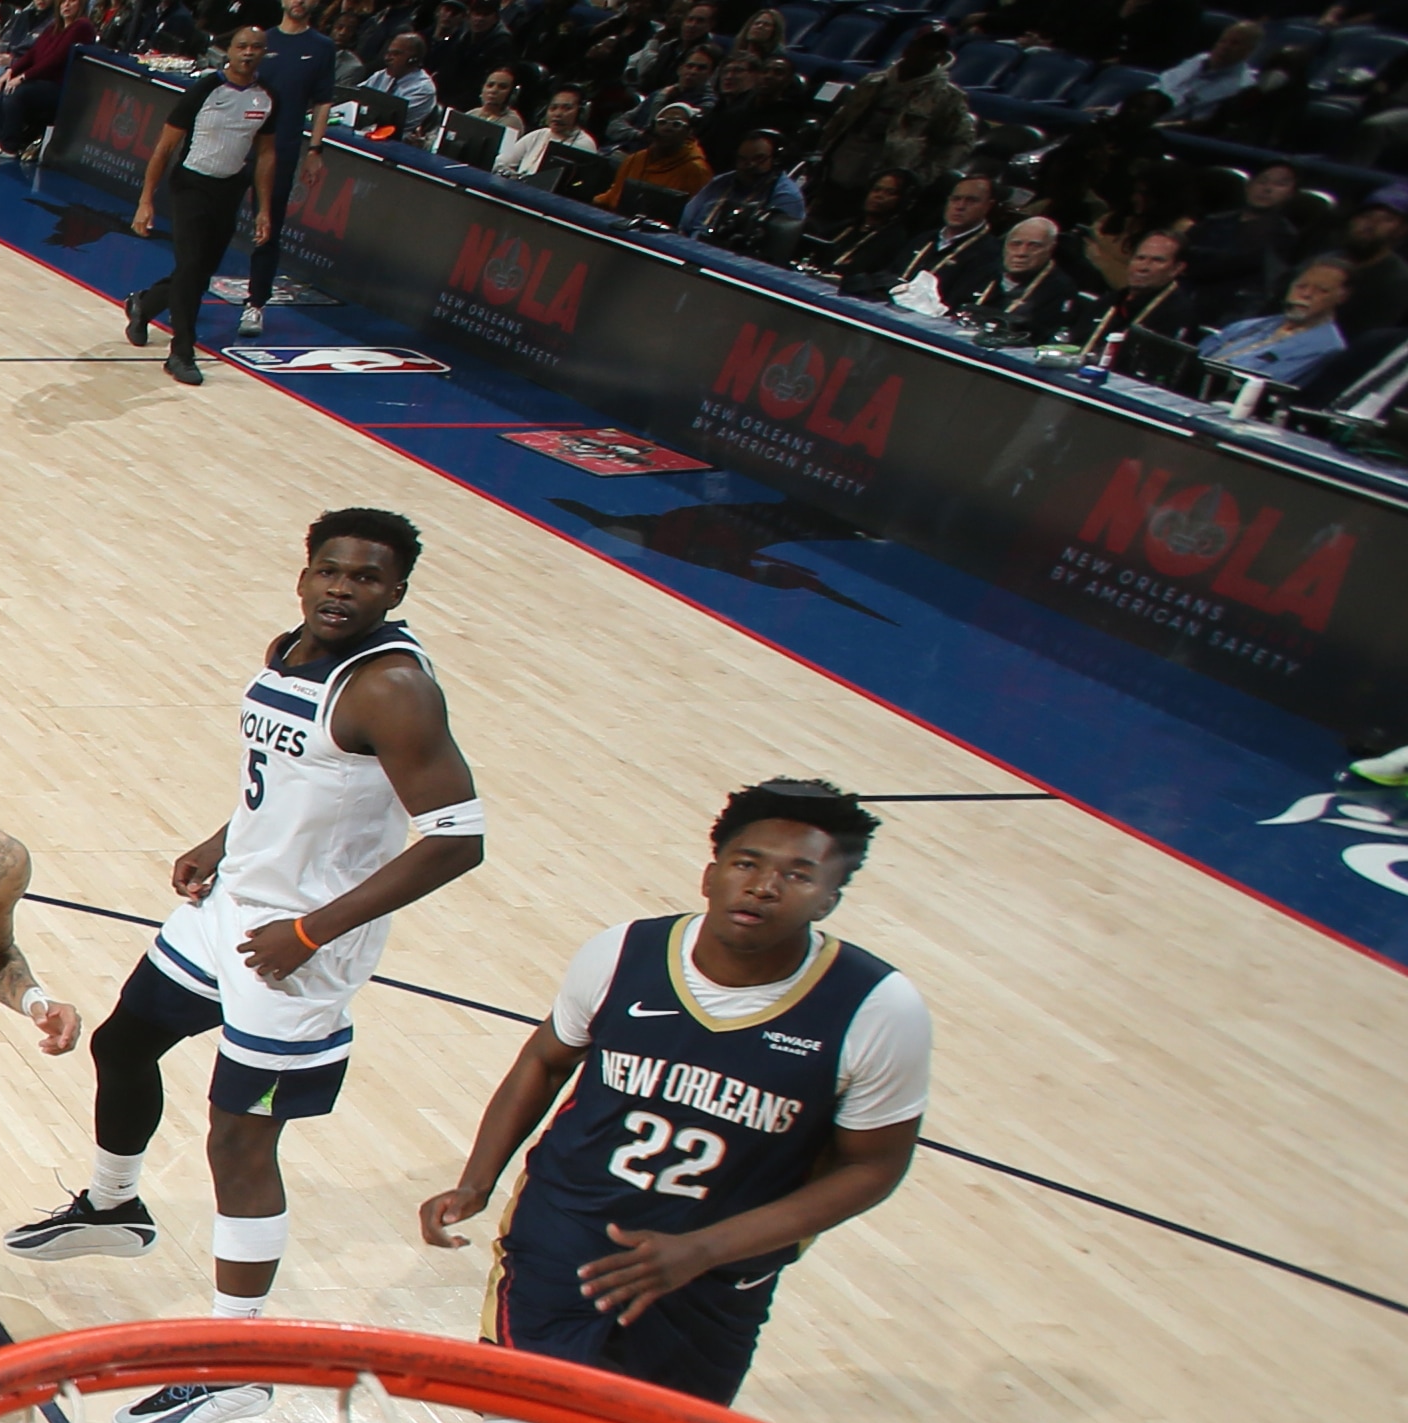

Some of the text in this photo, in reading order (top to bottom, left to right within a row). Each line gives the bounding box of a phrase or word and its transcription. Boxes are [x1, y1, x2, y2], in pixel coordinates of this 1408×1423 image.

[89, 88, 161, 160] NOL
[439, 291, 523, 334] NEW ORLEANS
[447, 222, 589, 335] NOLA
[433, 306, 449, 319] BY
[450, 314, 512, 347] AMERICAN
[514, 340, 561, 368] SAFETY
[700, 399, 815, 455] NEW ORLEANS
[711, 321, 905, 459] NOLA
[691, 415, 713, 433] BY
[717, 426, 798, 469] AMERICAN
[803, 461, 867, 497] SAFETY
[1061, 545, 1226, 622] NEW ORLEANS
[1076, 456, 1359, 635] NOLA
[1050, 564, 1079, 584] BY
[1084, 579, 1203, 638] AMERICAN
[1207, 629, 1301, 676] SAFETY
[244, 748, 268, 812] 5
[762, 1030, 823, 1051] NEWAGE
[601, 1049, 805, 1134] NEW ORLEANS
[607, 1110, 727, 1200] 22
